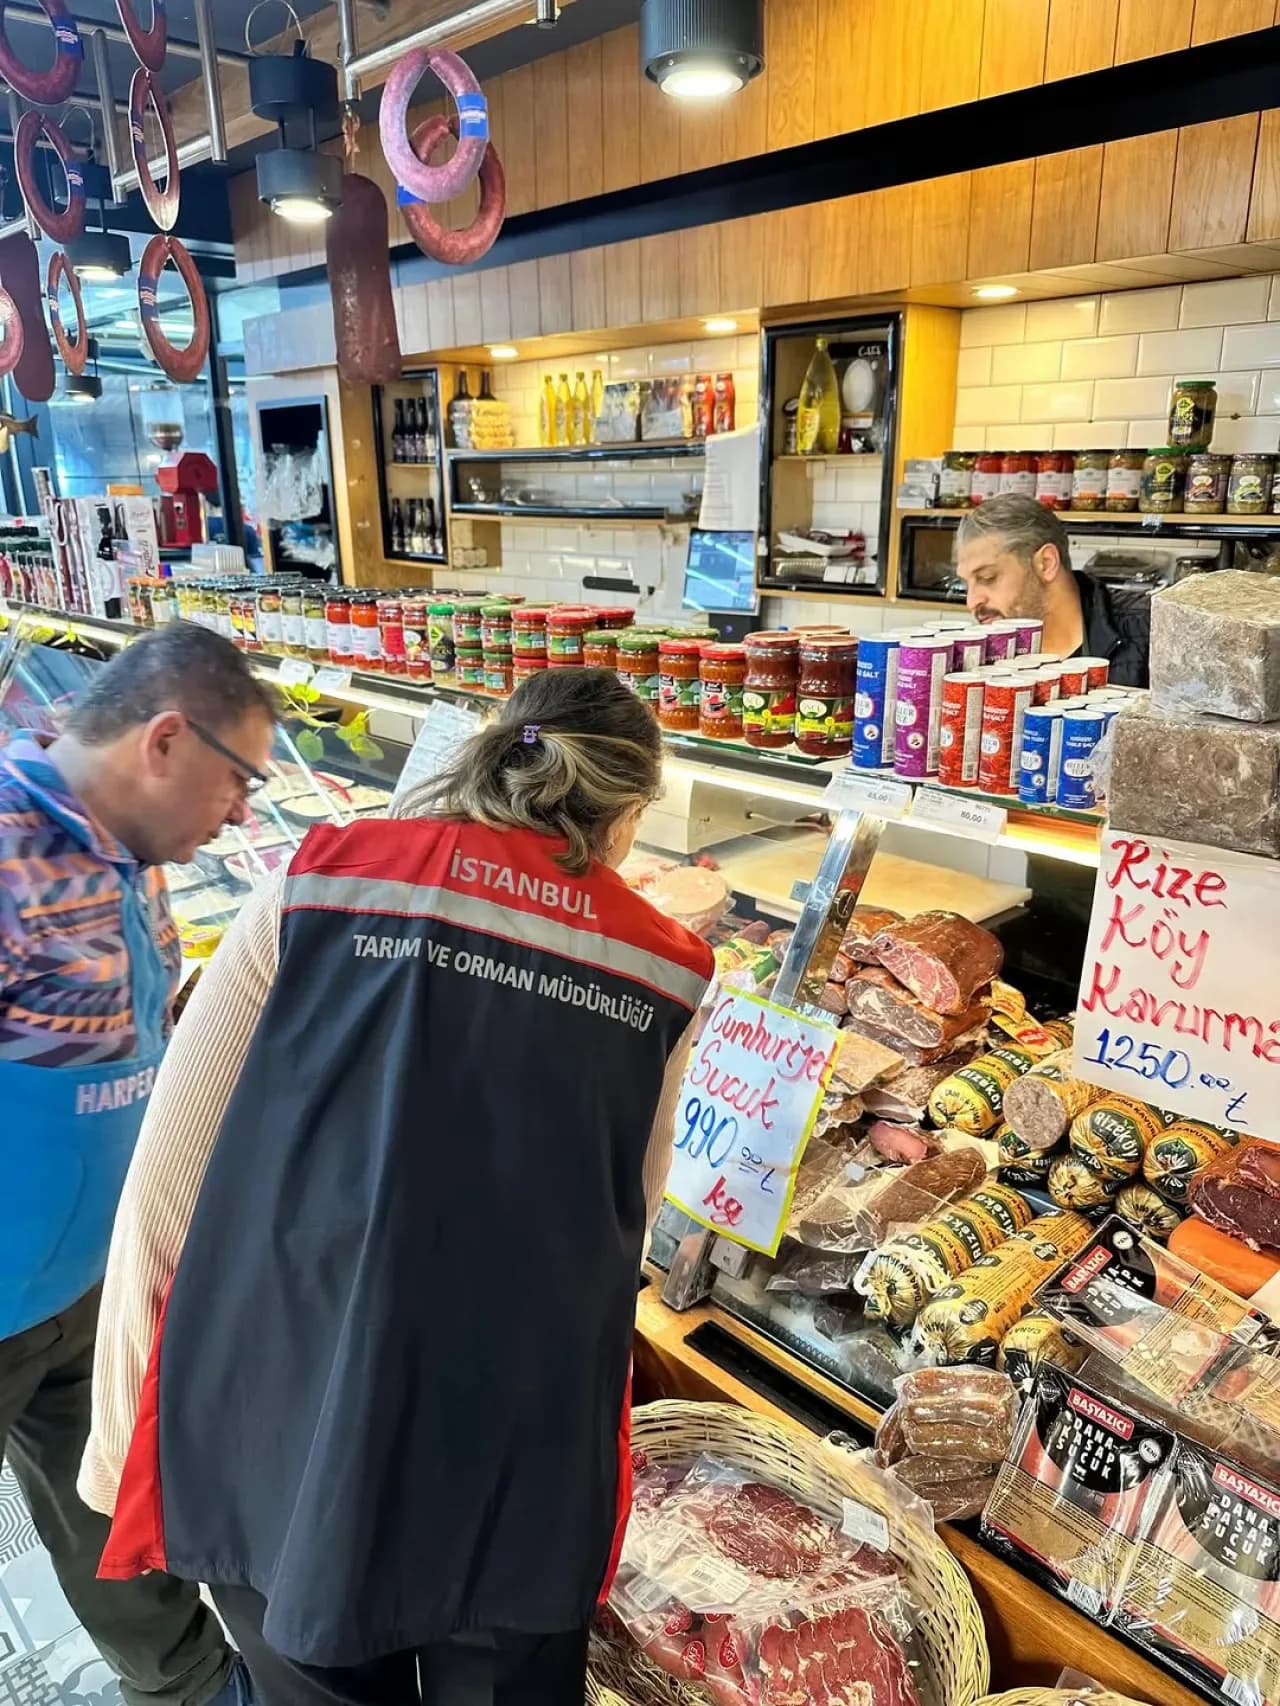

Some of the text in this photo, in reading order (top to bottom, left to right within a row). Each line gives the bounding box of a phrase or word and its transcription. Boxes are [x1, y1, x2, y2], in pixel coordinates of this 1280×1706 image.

[450, 848, 598, 919] İSTANBUL
[1106, 839, 1228, 909] Rize
[1100, 894, 1210, 990] Köy
[353, 933, 654, 1033] TARIM VE ORMAN MÜDÜRLÜĞÜ
[690, 1039, 779, 1130] Sucuk
[702, 1175, 744, 1226] kg
[1072, 1394, 1129, 1434] BAŞYAZICI
[1056, 1437, 1111, 1480] SUCUK
[1059, 1424, 1115, 1464] KASAP
[1218, 1469, 1280, 1513] BAŞYAZIC
[1200, 1516, 1268, 1565] SUCUK
